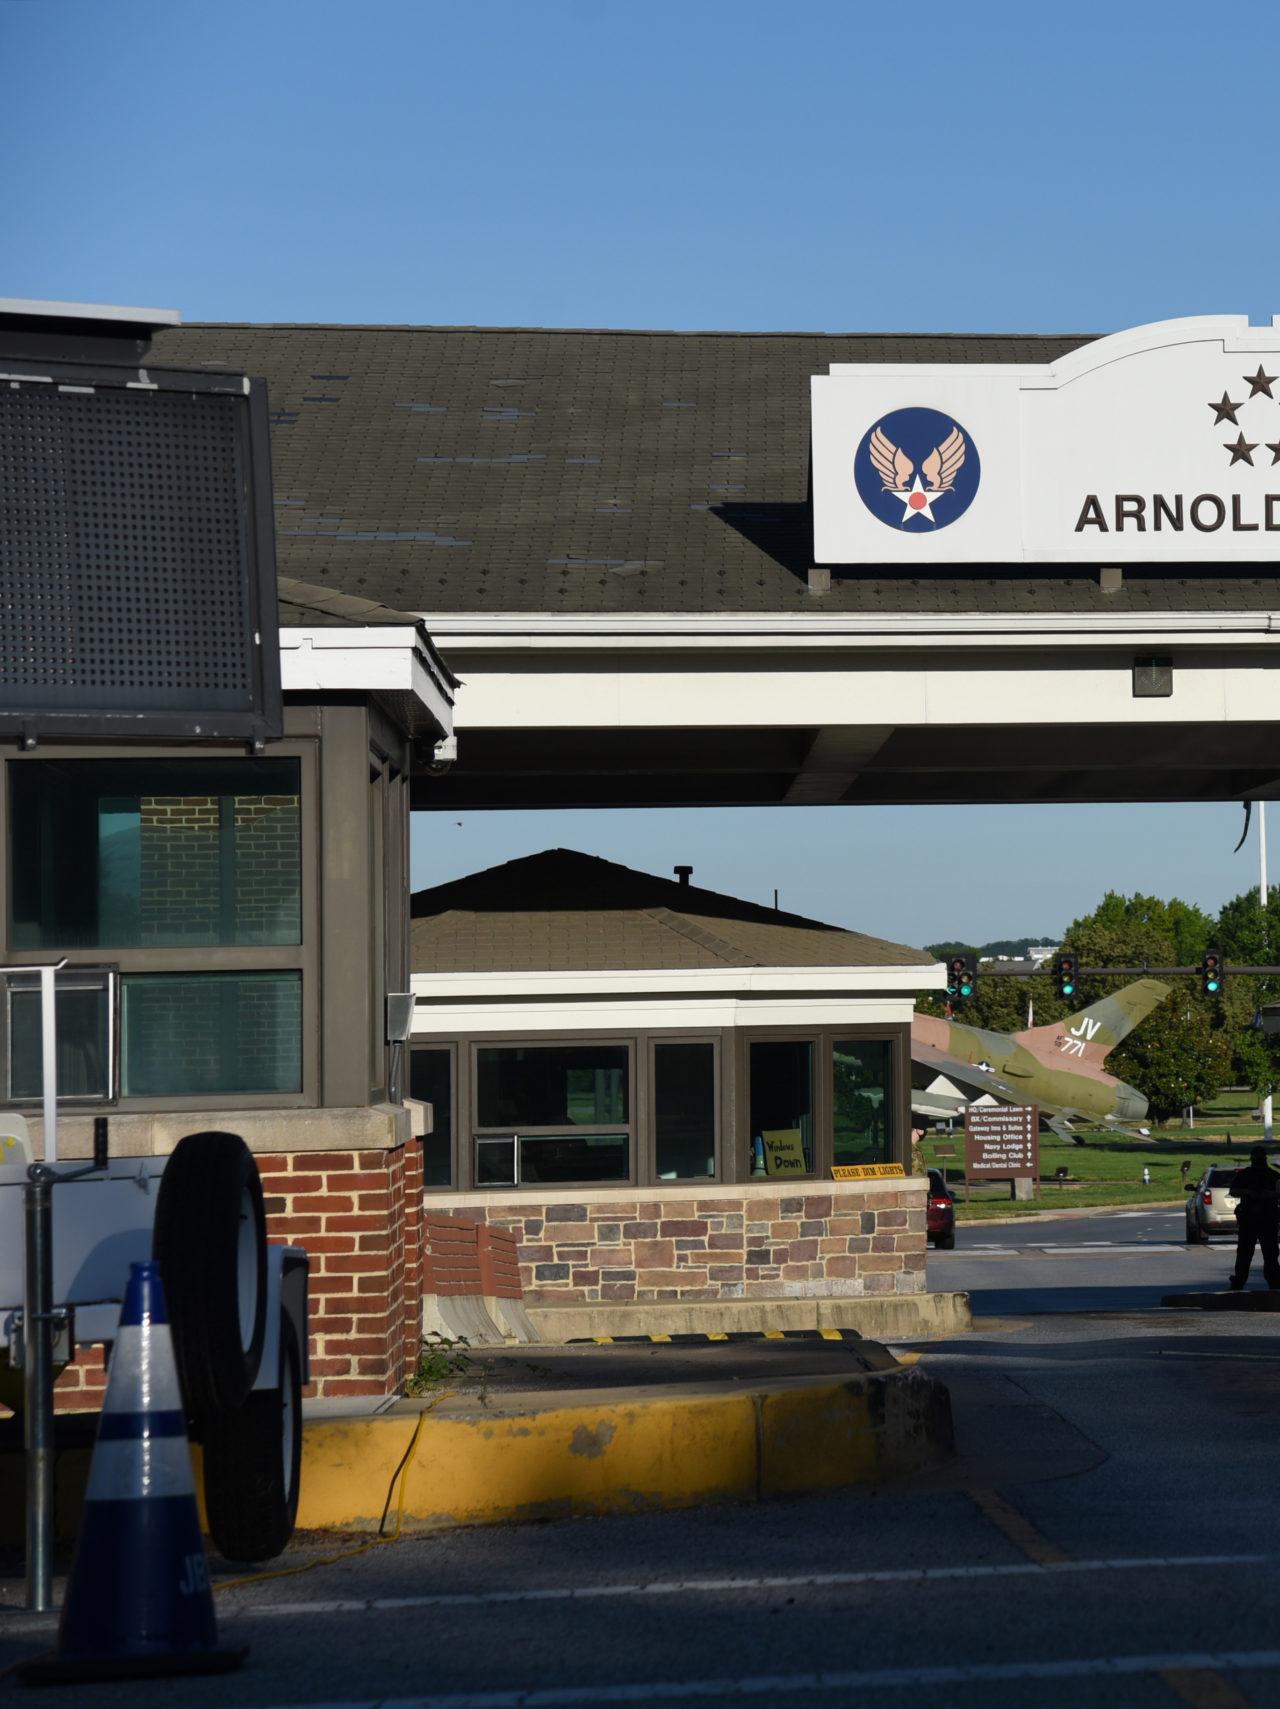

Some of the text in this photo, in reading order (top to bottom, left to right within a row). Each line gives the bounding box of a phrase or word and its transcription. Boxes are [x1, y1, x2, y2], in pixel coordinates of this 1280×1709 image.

[1070, 1017, 1101, 1040] JV
[1060, 1036, 1086, 1057] 771
[766, 1140, 795, 1152] Windows
[774, 1155, 802, 1170] Down
[982, 1152, 1007, 1160] Bolling
[833, 1165, 904, 1178] PLEASE DIM LIGHTS
